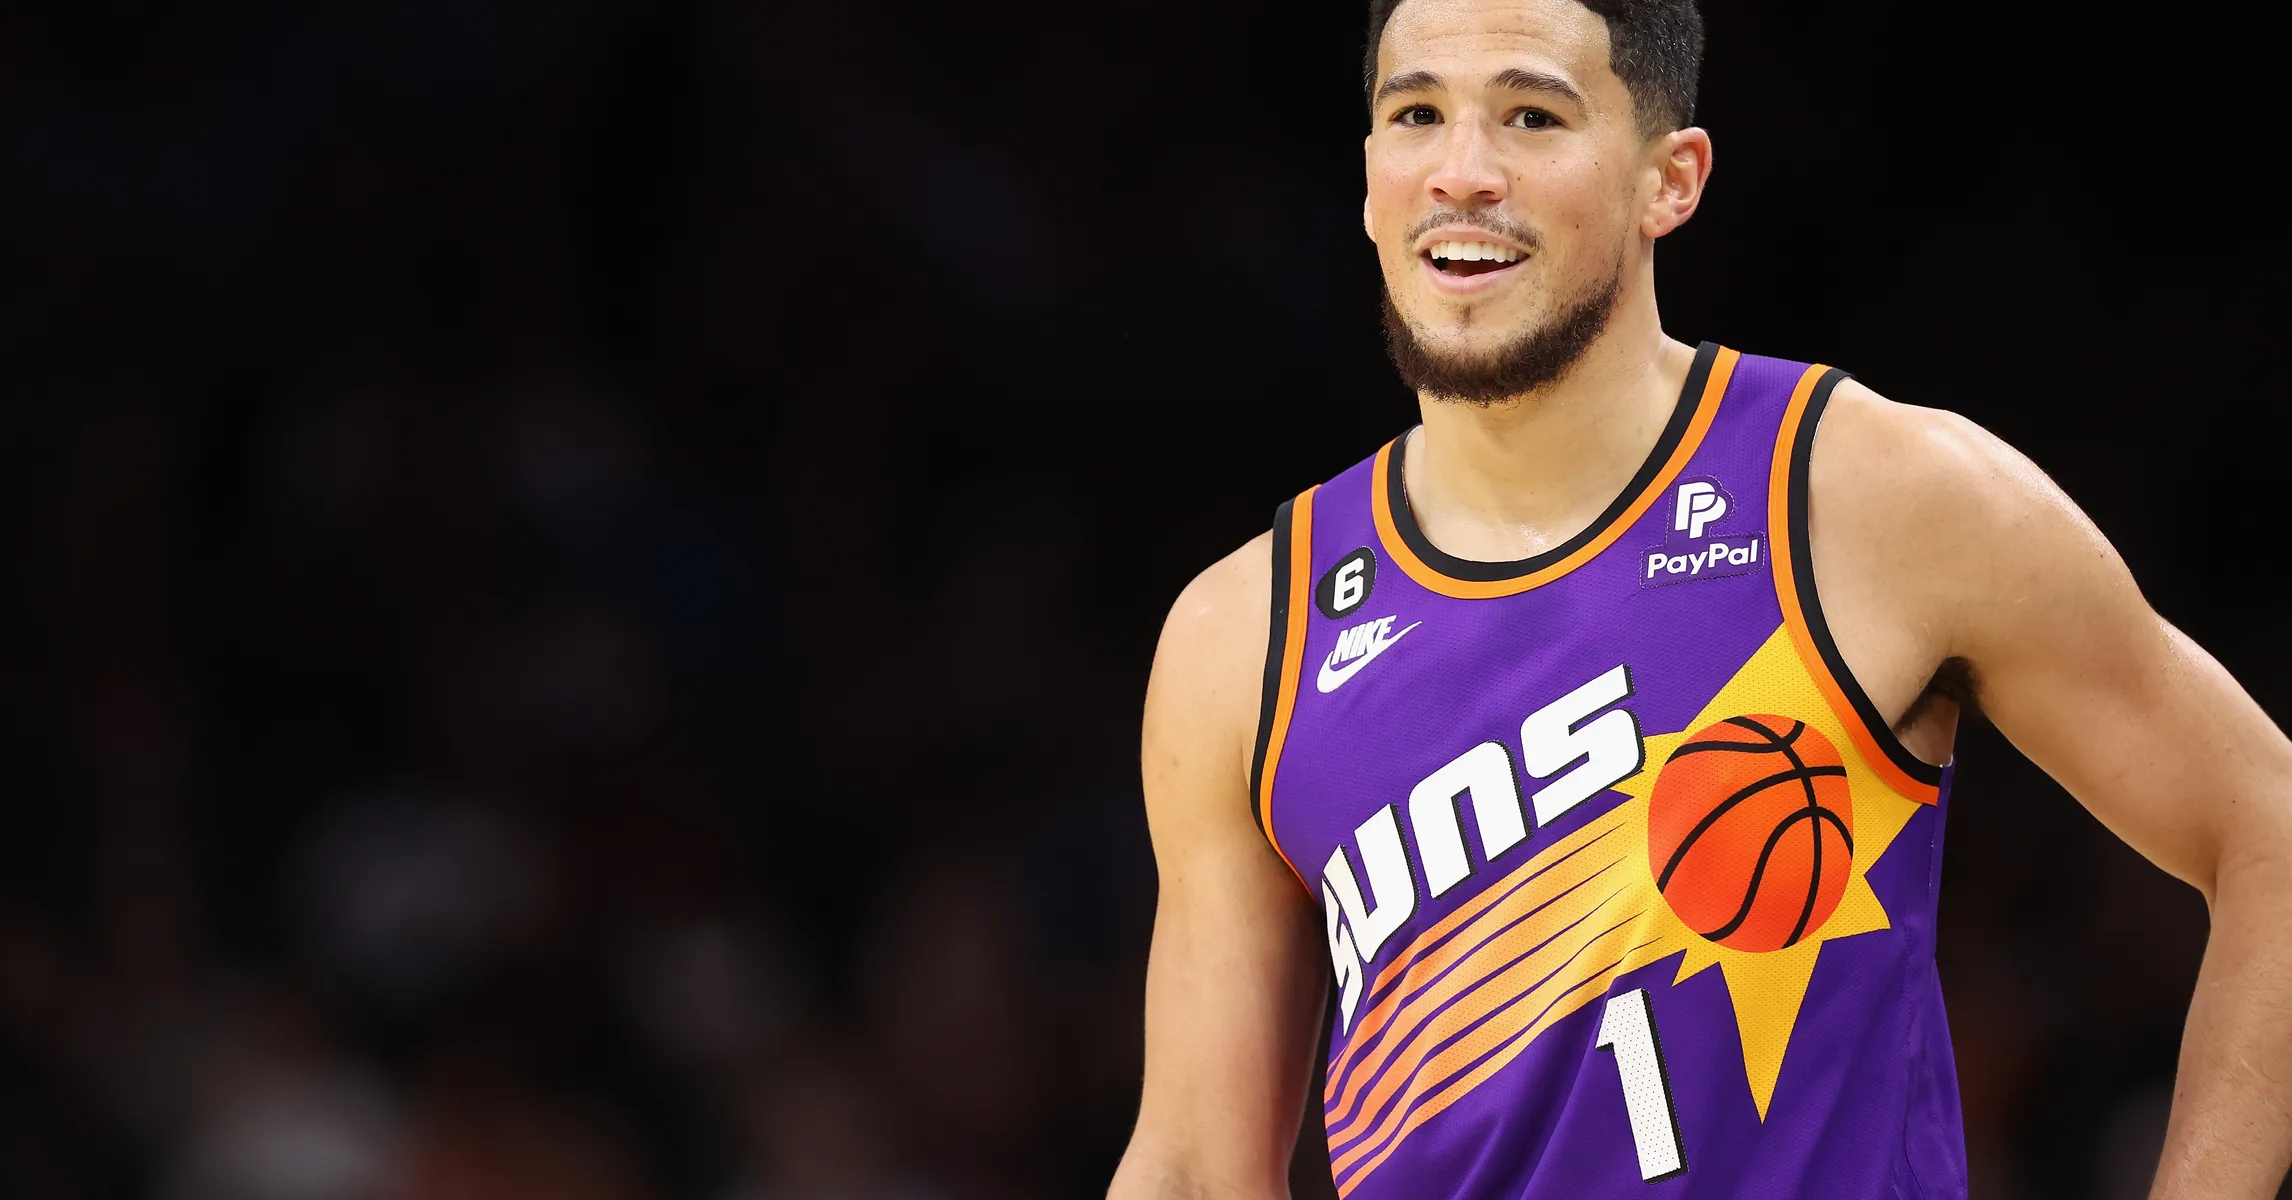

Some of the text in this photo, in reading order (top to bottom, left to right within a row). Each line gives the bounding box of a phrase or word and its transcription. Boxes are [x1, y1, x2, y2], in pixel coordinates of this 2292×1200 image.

[1332, 557, 1365, 612] 6
[1647, 539, 1758, 579] PayPal
[1331, 614, 1398, 666] NIKE
[1595, 988, 1689, 1184] 1
